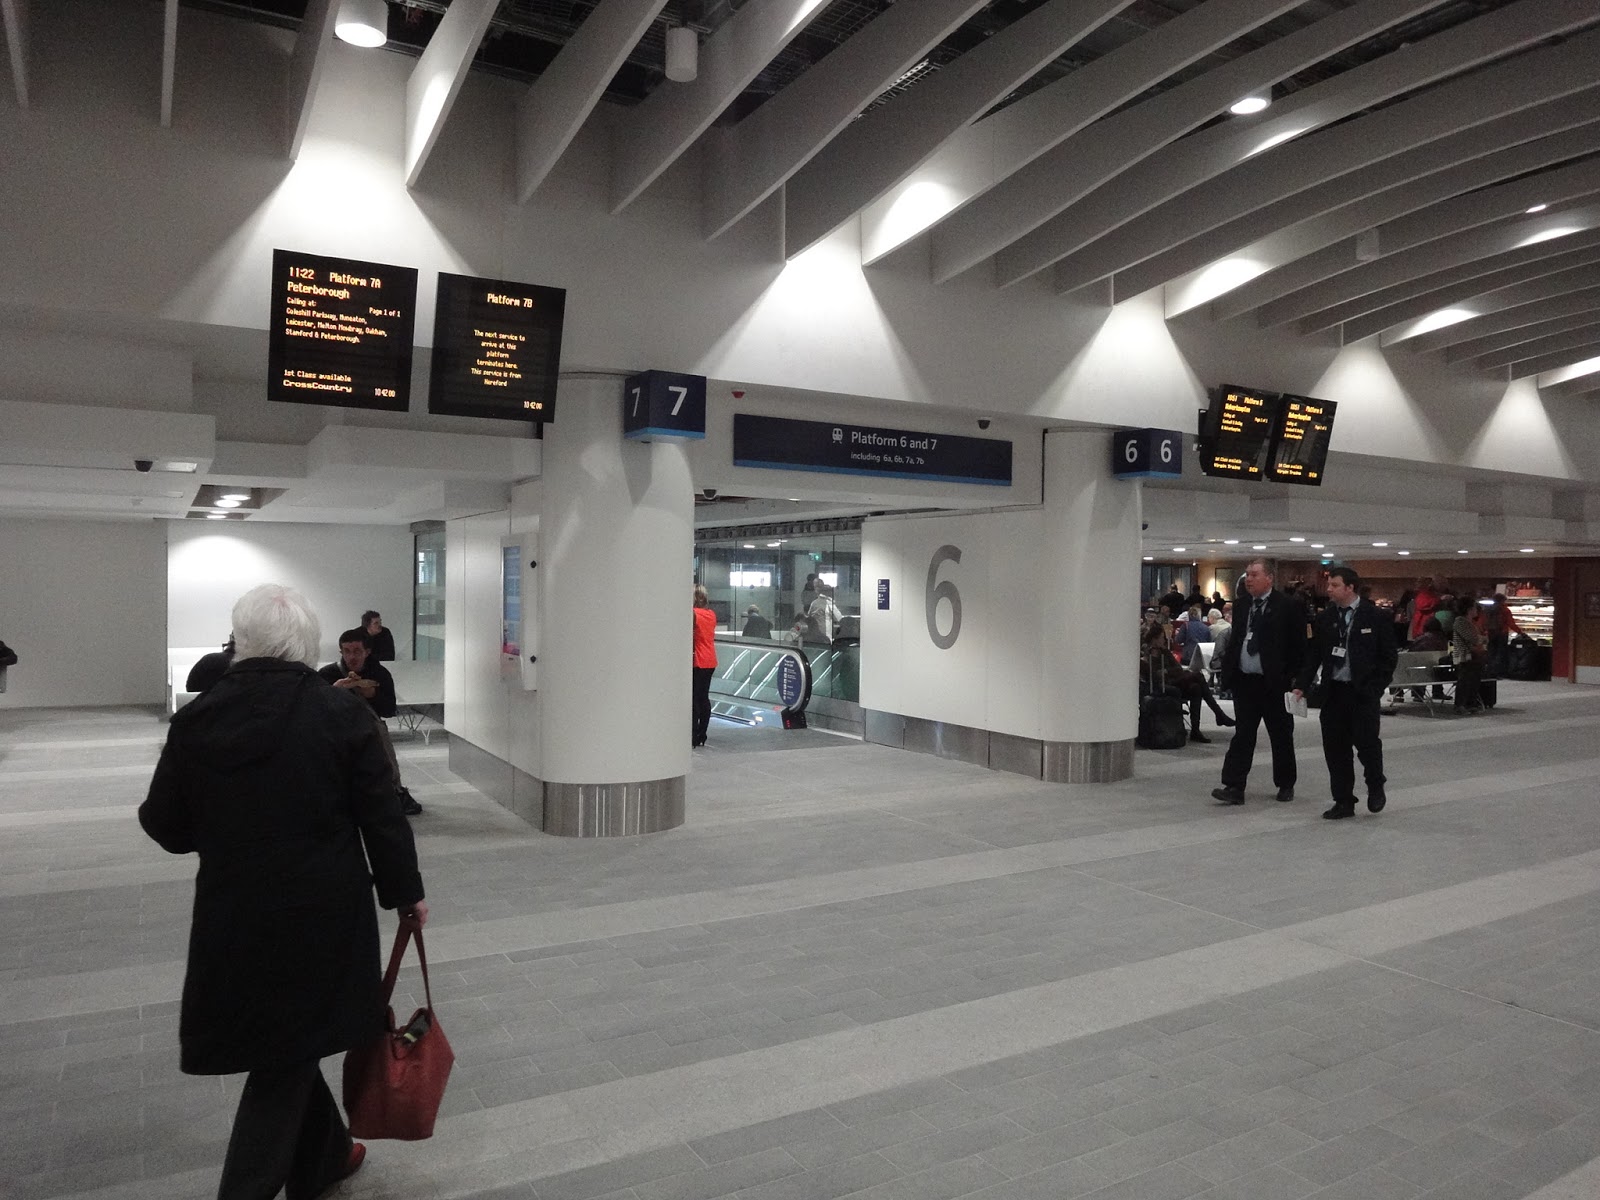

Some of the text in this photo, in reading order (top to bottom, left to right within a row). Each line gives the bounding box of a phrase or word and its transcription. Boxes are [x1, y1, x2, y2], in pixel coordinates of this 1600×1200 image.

[289, 266, 381, 289] 11:22 Platform 7A
[287, 280, 350, 300] Peterborough
[286, 296, 307, 307] Calling
[486, 292, 533, 308] Platform 7B
[368, 306, 382, 317] Page
[388, 309, 396, 317] of
[285, 327, 314, 338] Stamford
[473, 329, 526, 342] The next service to
[284, 369, 352, 382] 1st Class available
[471, 367, 482, 375] This
[509, 371, 522, 379] from
[282, 379, 353, 393] CrossCountry
[668, 385, 688, 416] 7
[851, 431, 937, 450] Platform 6 and 7
[850, 451, 881, 463] including
[916, 457, 925, 465] 7b
[1125, 439, 1138, 463] 6
[1160, 439, 1172, 463] 6
[925, 544, 962, 650] 6
